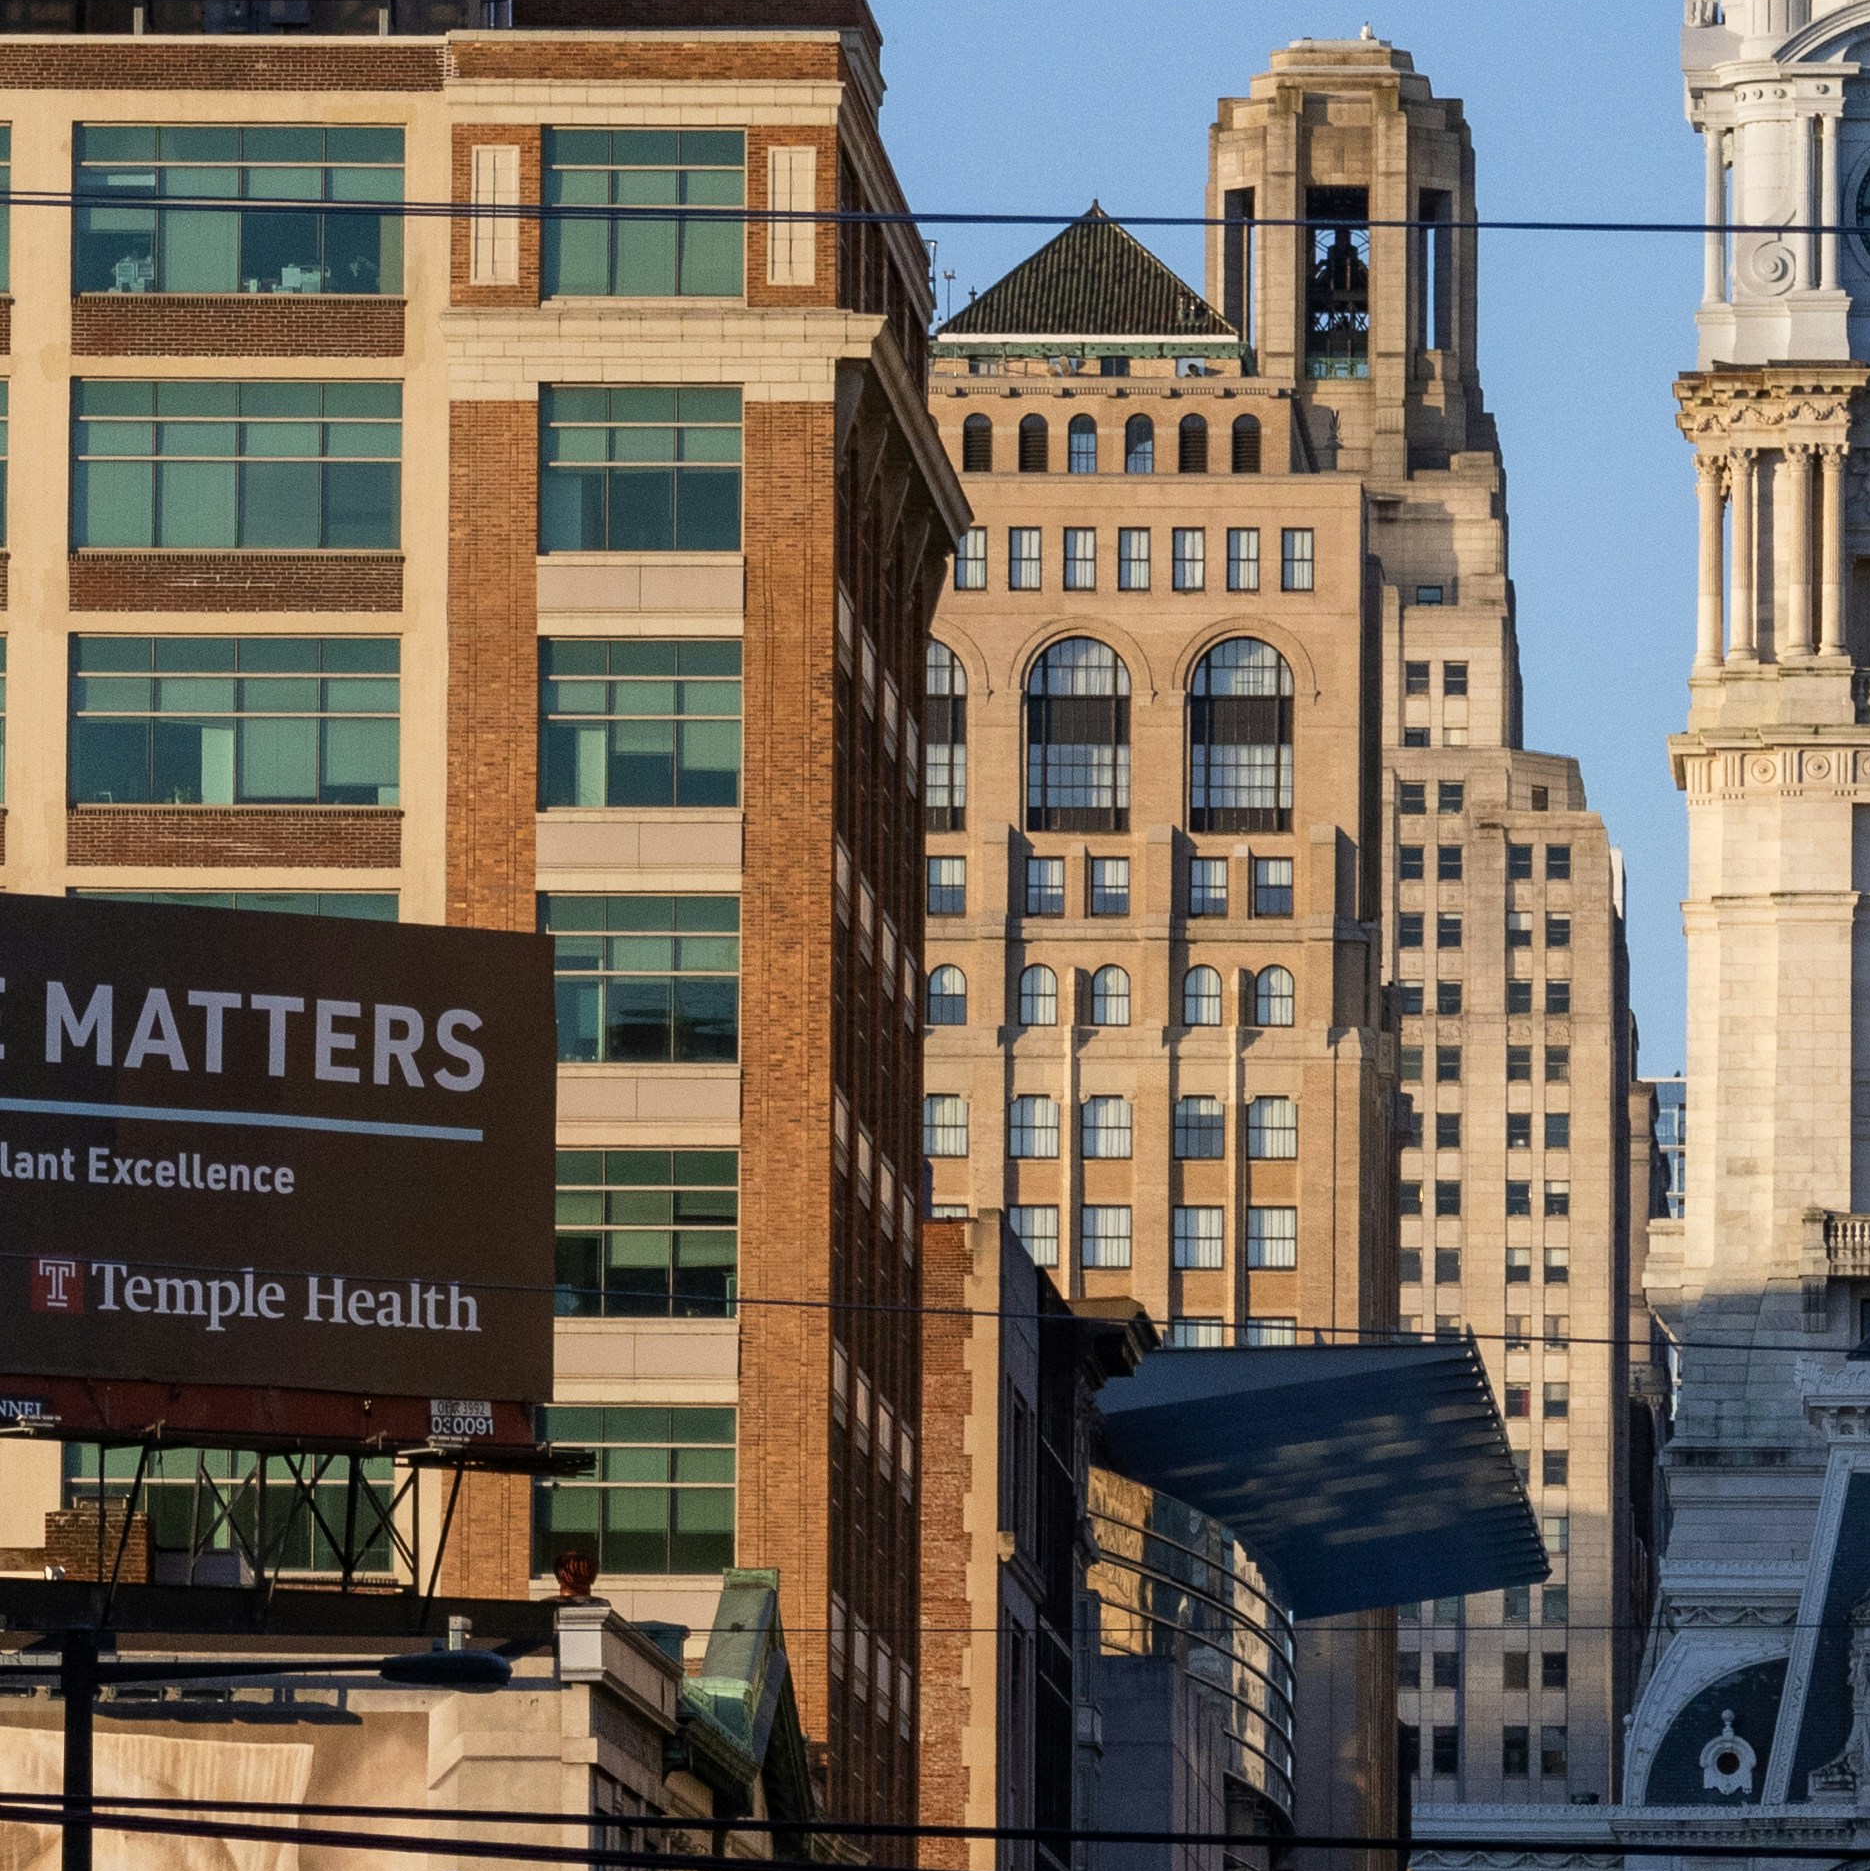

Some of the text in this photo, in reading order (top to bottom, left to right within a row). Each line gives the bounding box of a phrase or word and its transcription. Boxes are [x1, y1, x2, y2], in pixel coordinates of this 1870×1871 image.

[45, 980, 485, 1092] MATTERS
[88, 1146, 295, 1195] Excellence
[91, 1261, 482, 1332] Temple Health
